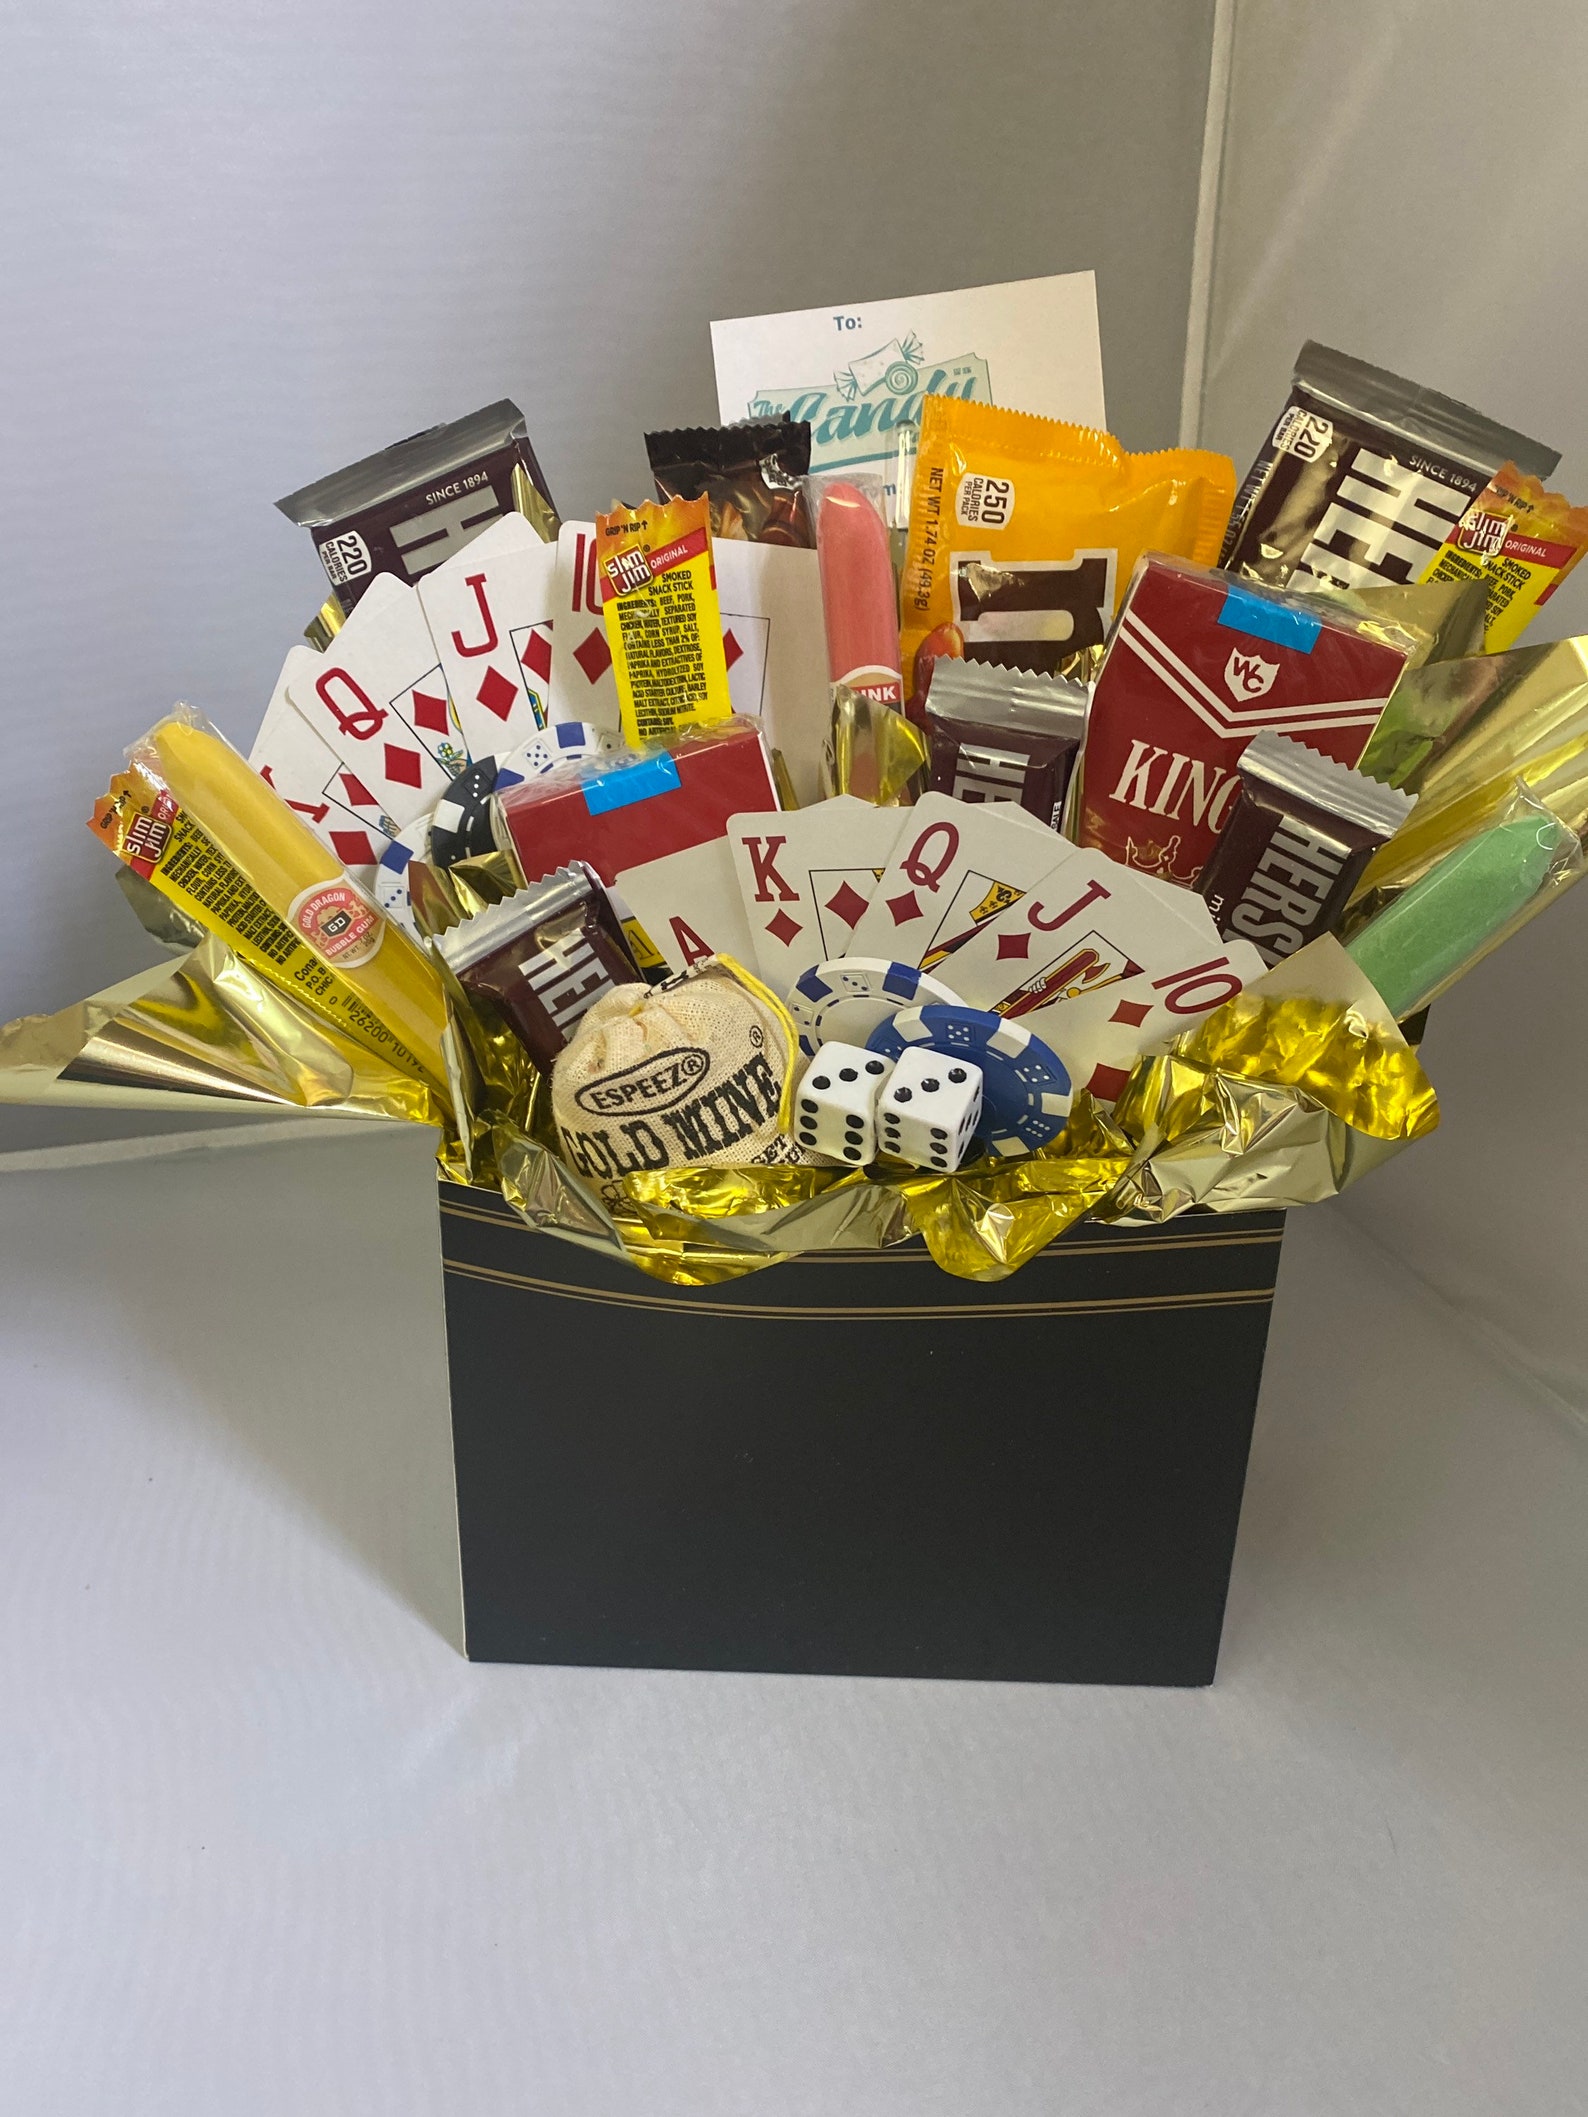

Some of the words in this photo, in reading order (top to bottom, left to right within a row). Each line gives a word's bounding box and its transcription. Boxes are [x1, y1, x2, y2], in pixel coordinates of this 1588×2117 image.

[833, 315, 863, 331] To:
[1278, 408, 1308, 451] CALORIES
[1282, 411, 1295, 427] PER
[1274, 425, 1287, 442] BAR
[1291, 414, 1330, 460] 220
[928, 466, 944, 492] NET
[1407, 453, 1449, 480] SINCE
[1447, 472, 1478, 493] 1894
[425, 482, 462, 506] SINCE
[463, 471, 489, 490] 1894
[963, 480, 973, 496] PER
[967, 476, 984, 522] CALORIES
[925, 494, 941, 515] WT
[960, 496, 970, 516] PACK
[980, 478, 1010, 525] 250
[605, 525, 620, 537] GRIP
[630, 522, 641, 532] RIP
[923, 518, 939, 545] 1.74
[322, 540, 350, 582] CALORIES
[333, 532, 371, 577] 220
[650, 545, 688, 570] ORIGINAL
[920, 547, 936, 565] OZ
[1504, 539, 1548, 557] ORIGINAL
[320, 550, 332, 565] PER
[326, 564, 338, 580] BAR
[662, 570, 692, 583] SMOKED
[1501, 557, 1532, 581] SMOKED
[648, 583, 672, 596] SNACK
[673, 581, 694, 592] STICK
[912, 567, 934, 612] (49.3g)
[1503, 569, 1526, 590] STICK
[451, 573, 499, 658] J
[660, 613, 687, 625] TEXTURED
[686, 612, 697, 622] SOY
[663, 602, 696, 615] SEPARATED
[650, 637, 665, 648] LESS
[665, 635, 680, 645] THAN
[692, 662, 704, 672] SOY
[695, 652, 703, 661] OF
[315, 667, 389, 741] Q
[863, 685, 898, 702] INK
[173, 819, 195, 843] SNACK
[159, 839, 193, 876] INGREDIENTS:
[168, 845, 202, 883] MECHANICALLY
[742, 835, 799, 902] K
[899, 821, 960, 893] Q
[185, 874, 206, 896] FLOUR,
[200, 860, 217, 878] CORN
[193, 875, 218, 902] CONTAINS
[212, 864, 228, 880] LESS
[201, 885, 223, 908] NATURAL
[209, 892, 231, 915] PAPRIKA
[226, 883, 239, 897] AND
[1027, 879, 1112, 932] J
[234, 919, 249, 934] ACID
[243, 902, 263, 924] STARTER
[301, 906, 314, 931] GOLD
[309, 891, 348, 912] DRAGON
[326, 915, 347, 933] GD
[242, 925, 257, 940] MALT
[323, 930, 359, 957] BUBBLE
[353, 914, 376, 934] GUM
[669, 916, 715, 967] A
[267, 947, 279, 959] NO
[275, 954, 286, 965] NO
[292, 953, 320, 983] Cona
[304, 971, 322, 990] P.O.
[313, 974, 334, 997] CHIC
[1151, 956, 1243, 1014] 10
[347, 1007, 390, 1046] 26200
[561, 1120, 670, 1182] GOLD
[662, 1052, 782, 1161] MINE
